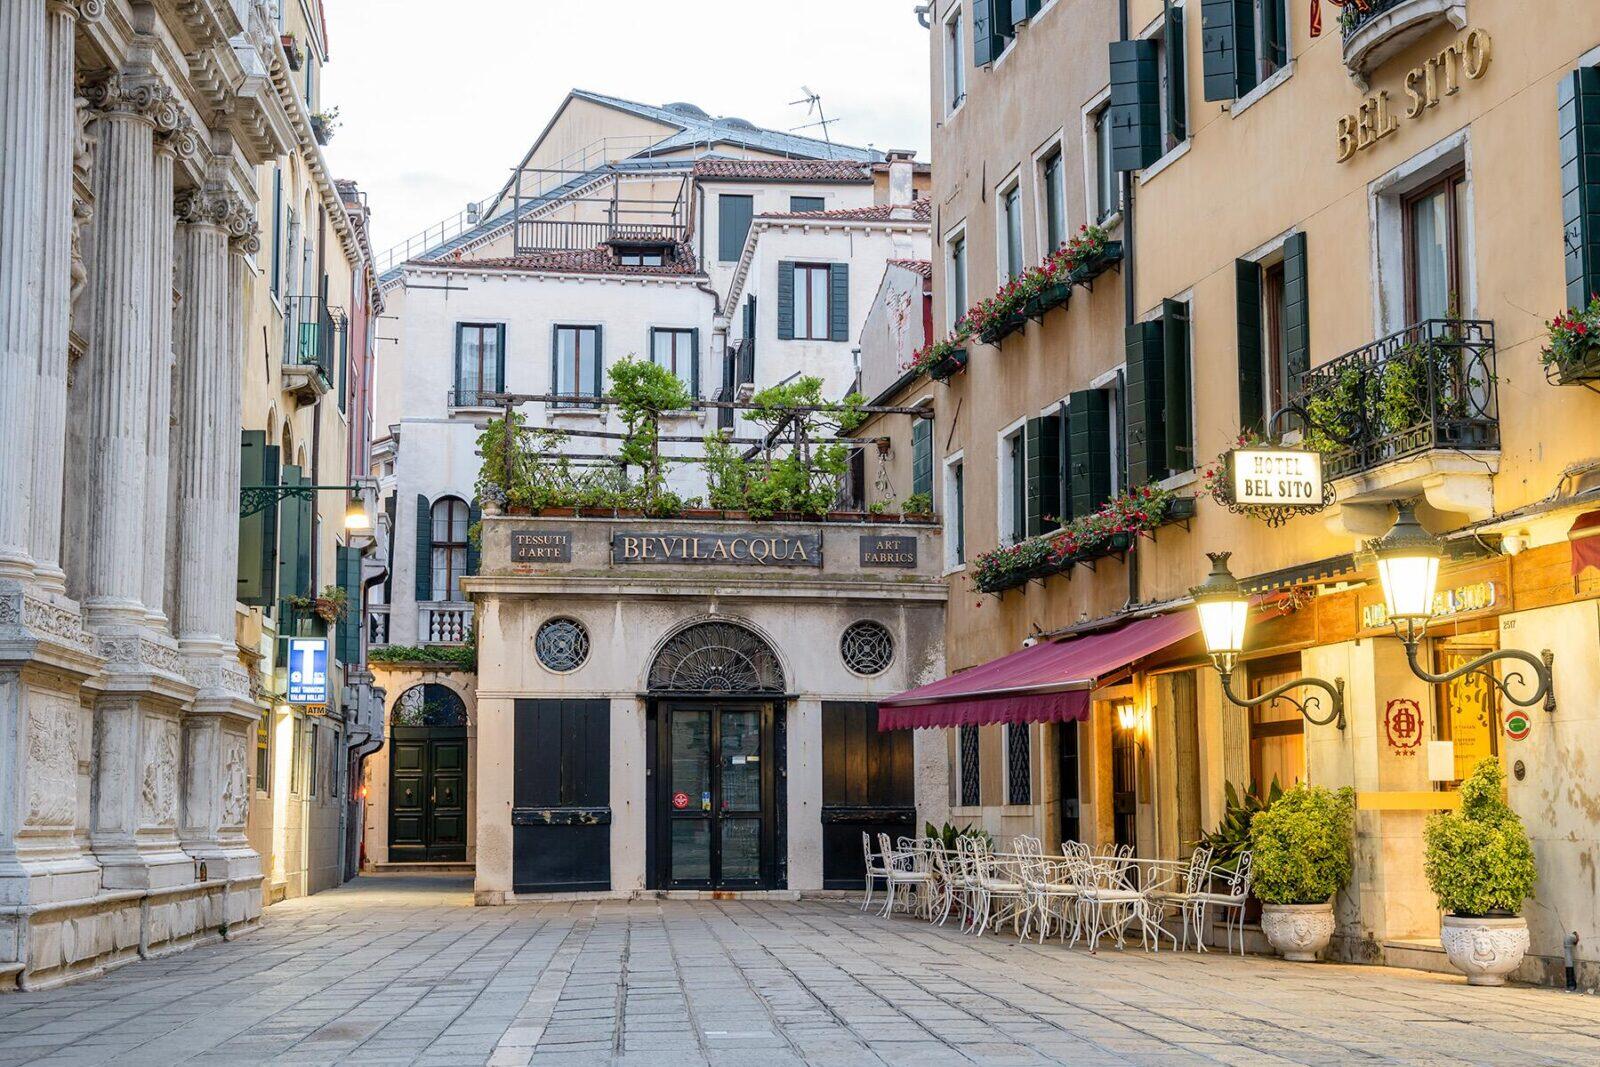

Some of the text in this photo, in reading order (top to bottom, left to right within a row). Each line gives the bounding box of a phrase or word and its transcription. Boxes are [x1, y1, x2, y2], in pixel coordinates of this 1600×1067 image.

[1336, 28, 1491, 163] BEL SITO
[1254, 456, 1303, 475] HOTEL
[1245, 479, 1312, 498] BEL SITO
[516, 535, 566, 545] TESSUTI
[876, 541, 901, 550] ART
[623, 536, 808, 565] BEVILACQUA
[865, 552, 914, 563] FABRICS
[293, 641, 325, 685] T
[308, 707, 325, 715] ATM
